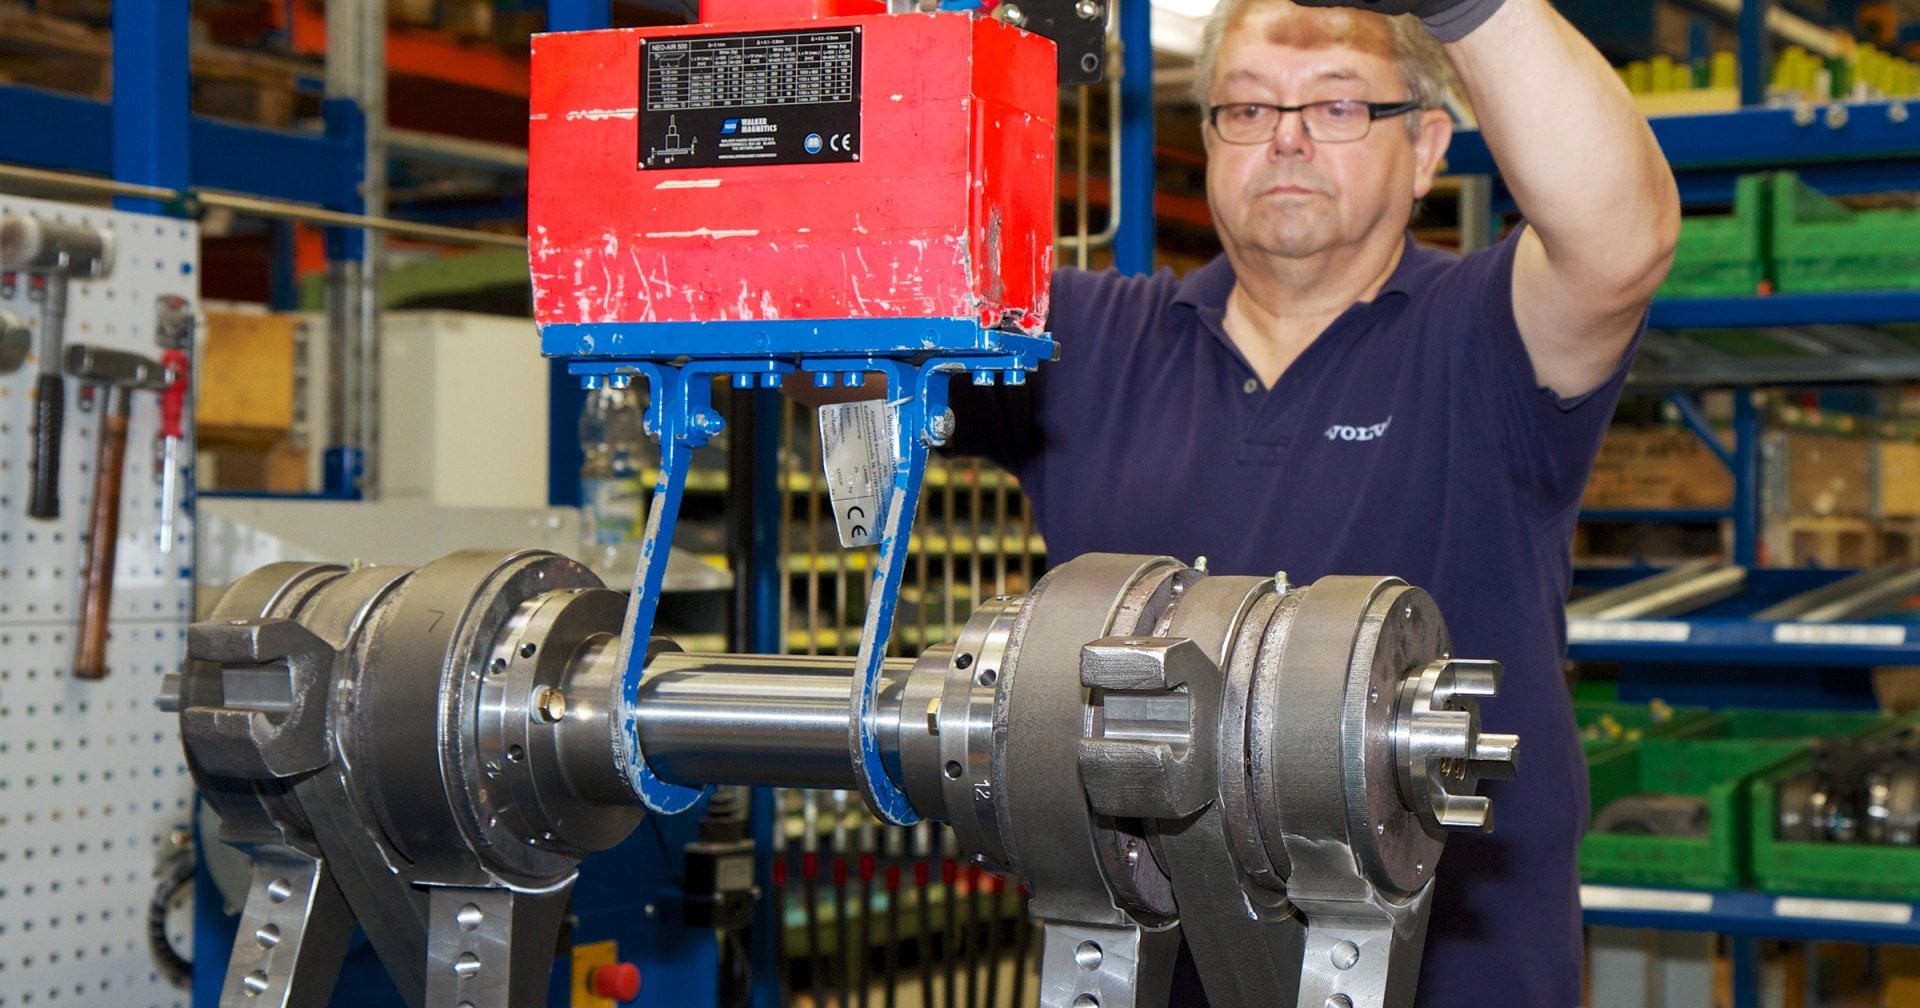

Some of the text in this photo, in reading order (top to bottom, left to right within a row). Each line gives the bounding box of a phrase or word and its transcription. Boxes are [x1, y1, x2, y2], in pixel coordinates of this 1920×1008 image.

[741, 117, 767, 126] WALKER
[741, 124, 777, 133] MAGNETICS
[829, 133, 850, 152] CE
[1324, 415, 1392, 441] VOLV
[847, 505, 867, 538] CE
[974, 779, 991, 801] 12
